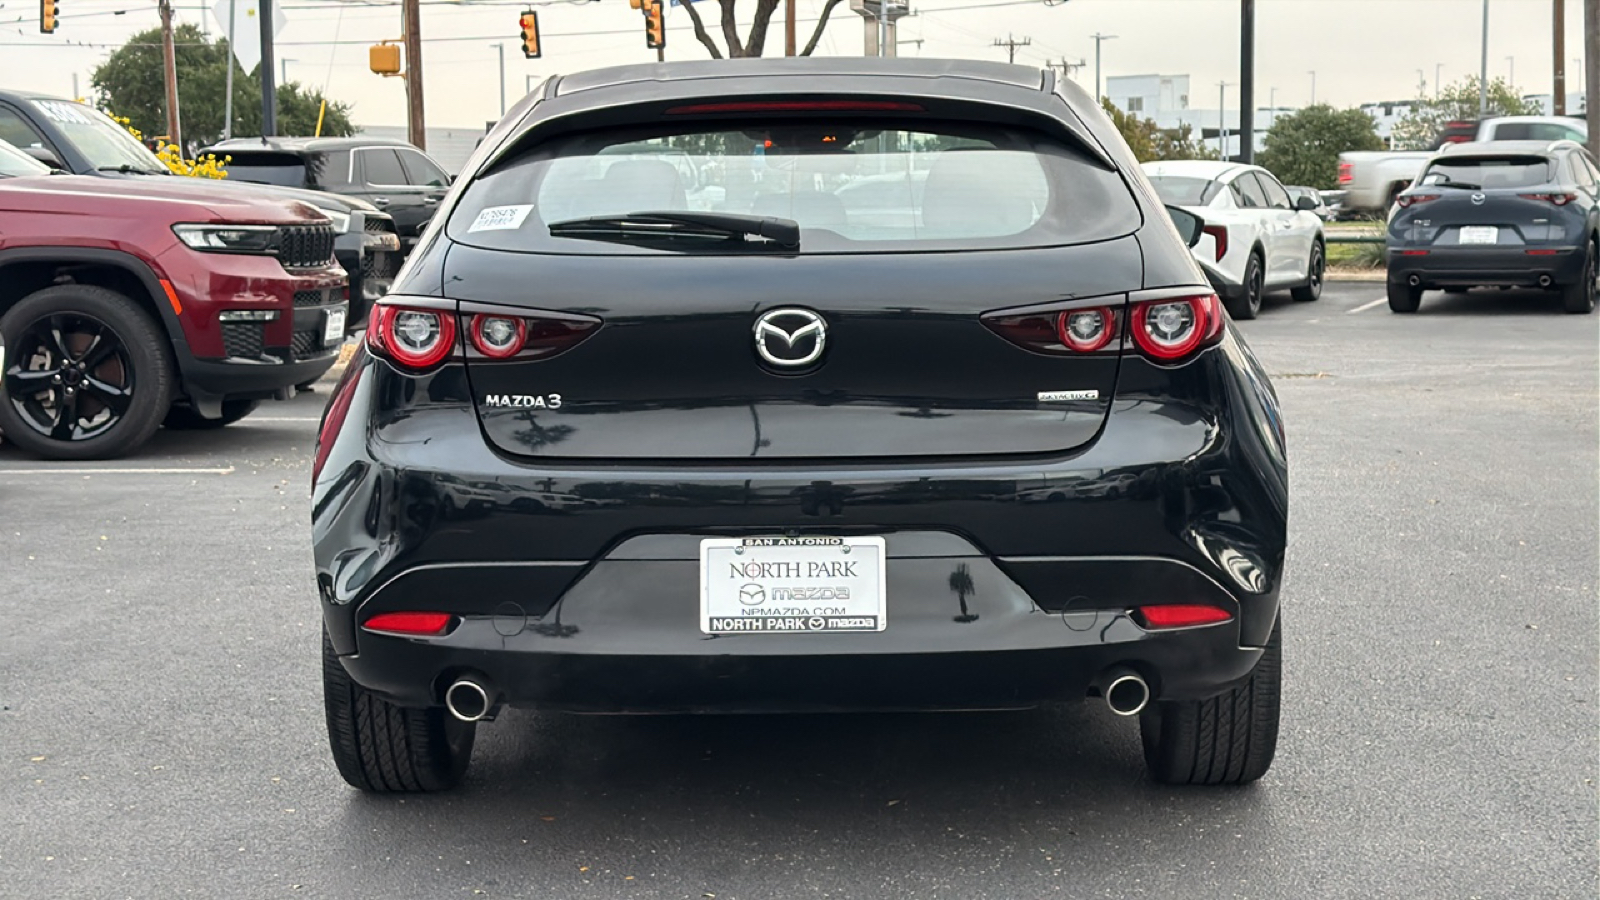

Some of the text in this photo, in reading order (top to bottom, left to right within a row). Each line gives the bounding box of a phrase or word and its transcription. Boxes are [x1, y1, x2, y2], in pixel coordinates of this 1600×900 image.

[745, 537, 841, 546] SAN ANTONIO
[729, 560, 858, 579] NORTH PARK
[771, 586, 850, 600] mazda
[741, 606, 846, 616] NPMAZDACOM
[712, 617, 875, 631] NORTH PARK mazda
